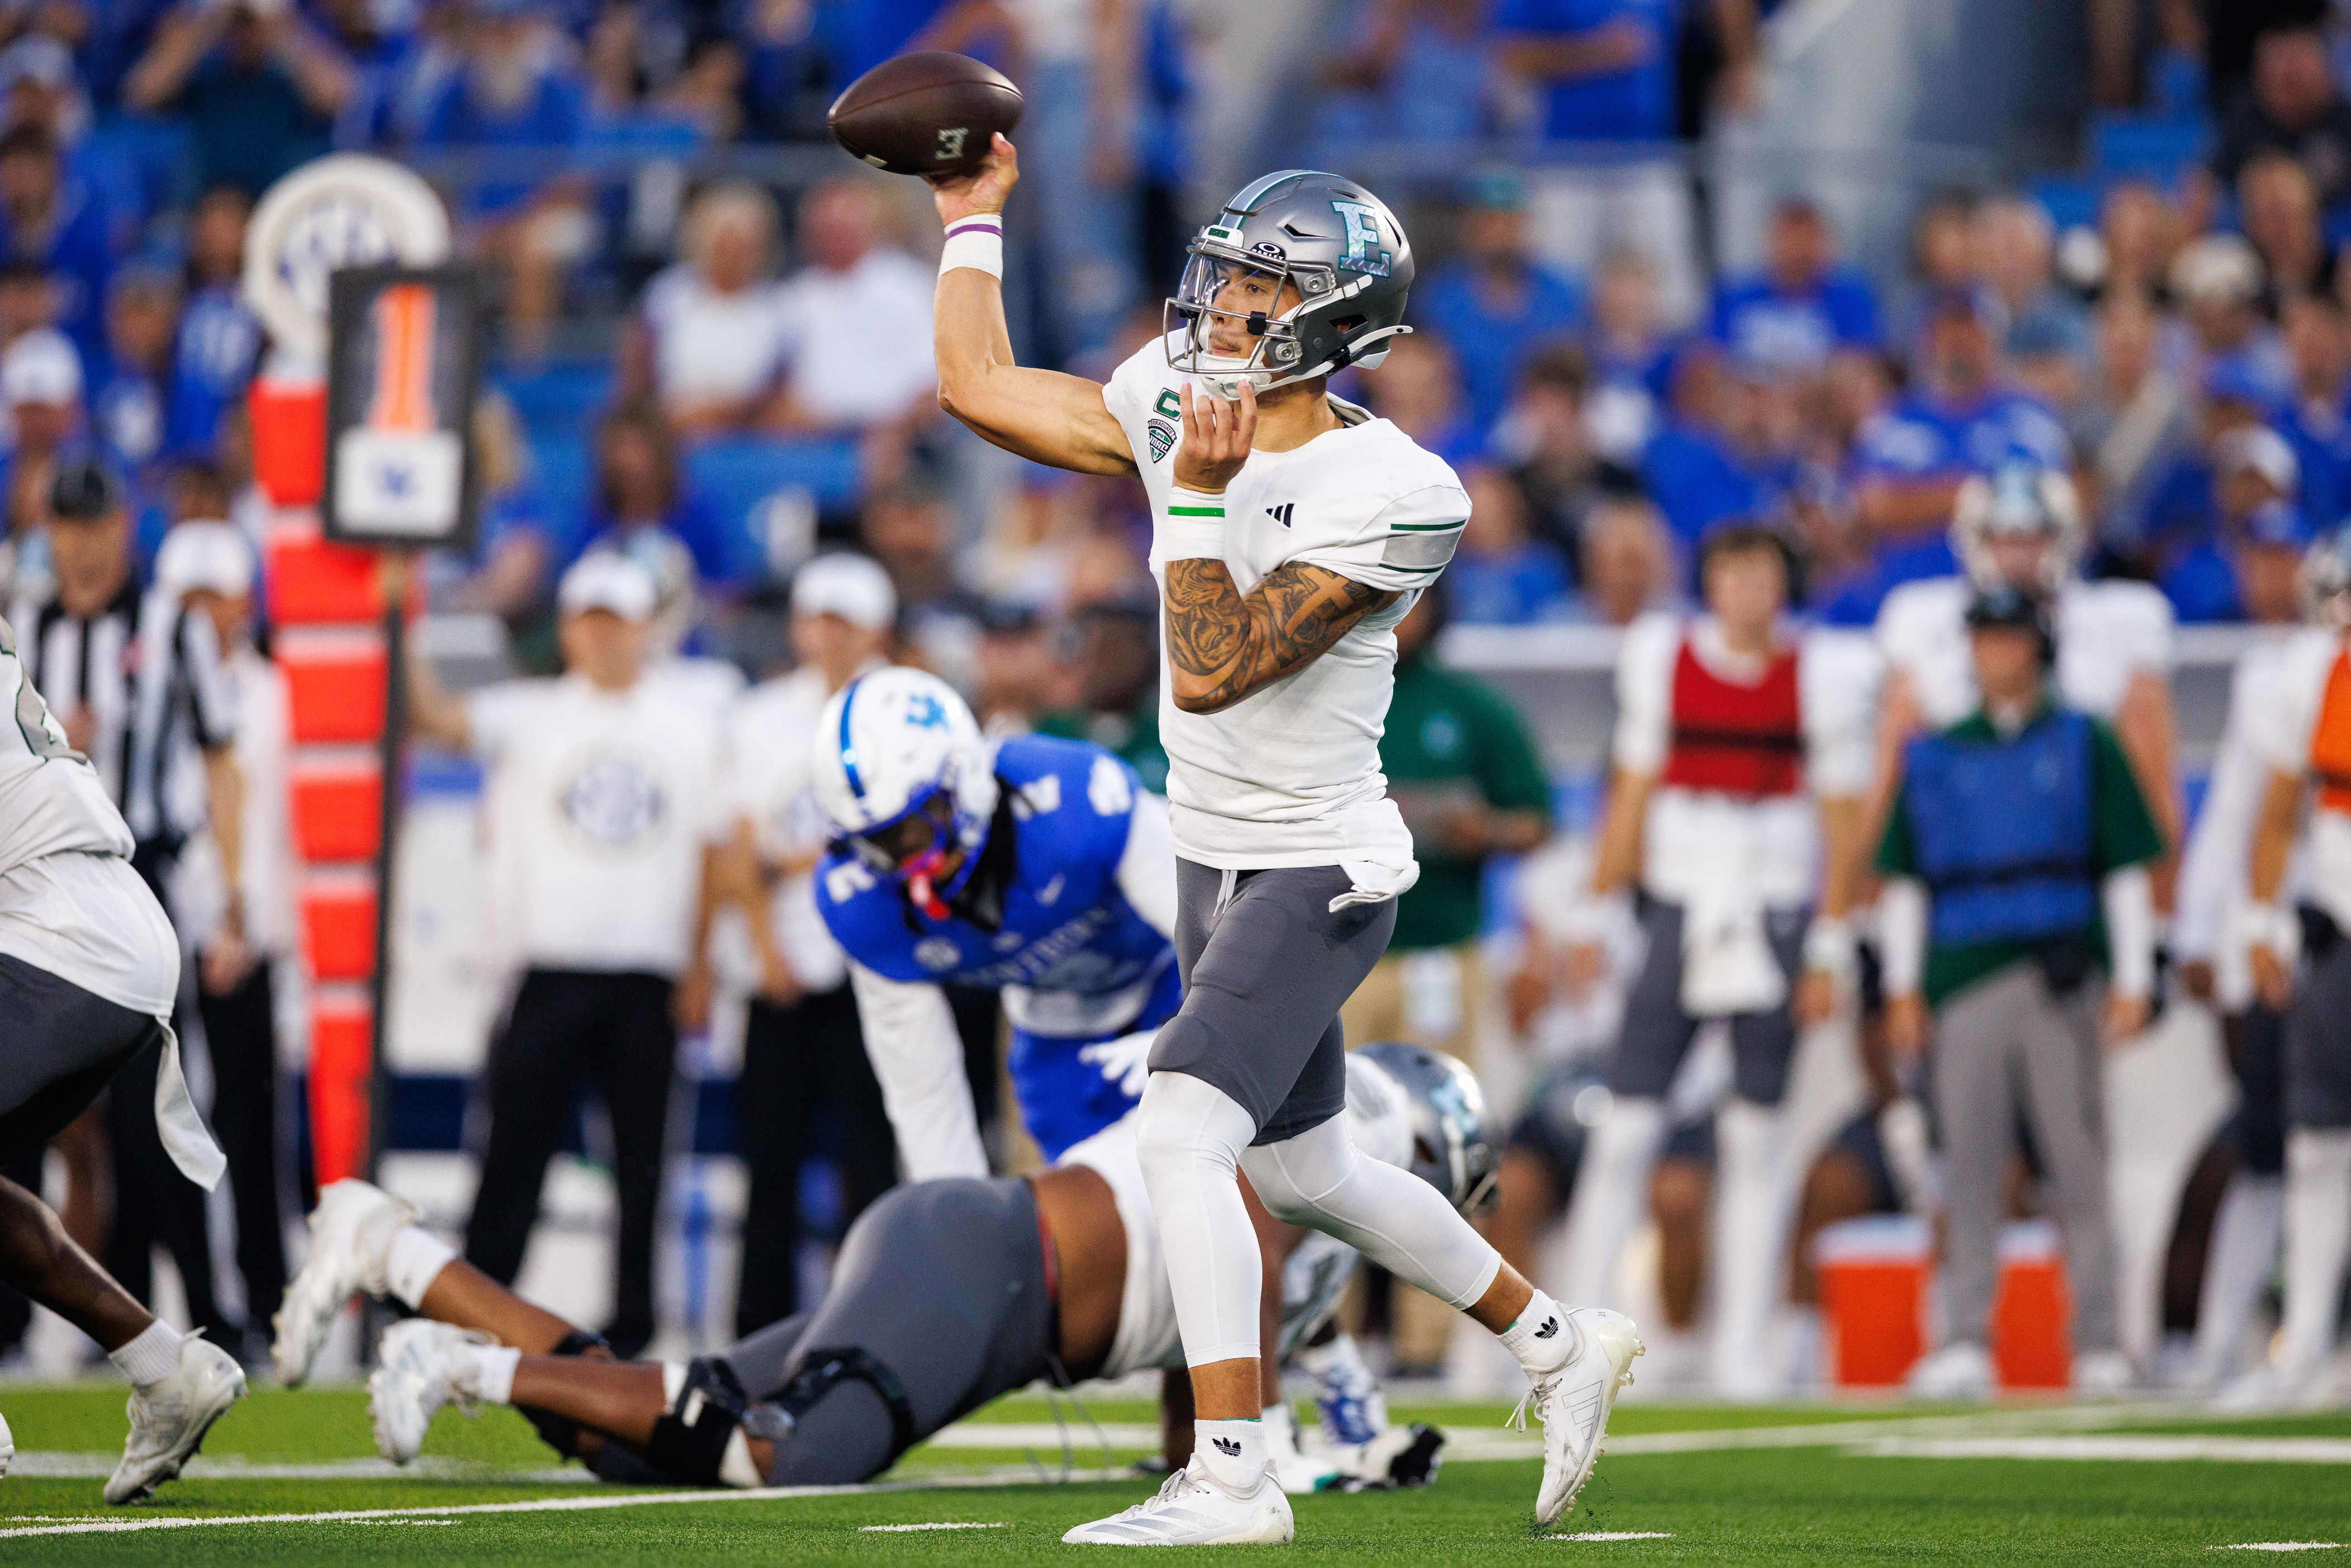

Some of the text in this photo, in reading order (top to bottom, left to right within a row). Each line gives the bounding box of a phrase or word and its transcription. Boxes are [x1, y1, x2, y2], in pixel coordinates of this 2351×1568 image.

[1330, 200, 1392, 279] E
[1252, 248, 1284, 260] OAKLEY
[1156, 391, 1181, 418] C
[1152, 420, 1173, 434] GRADUATE
[1149, 435, 1169, 453] MAC
